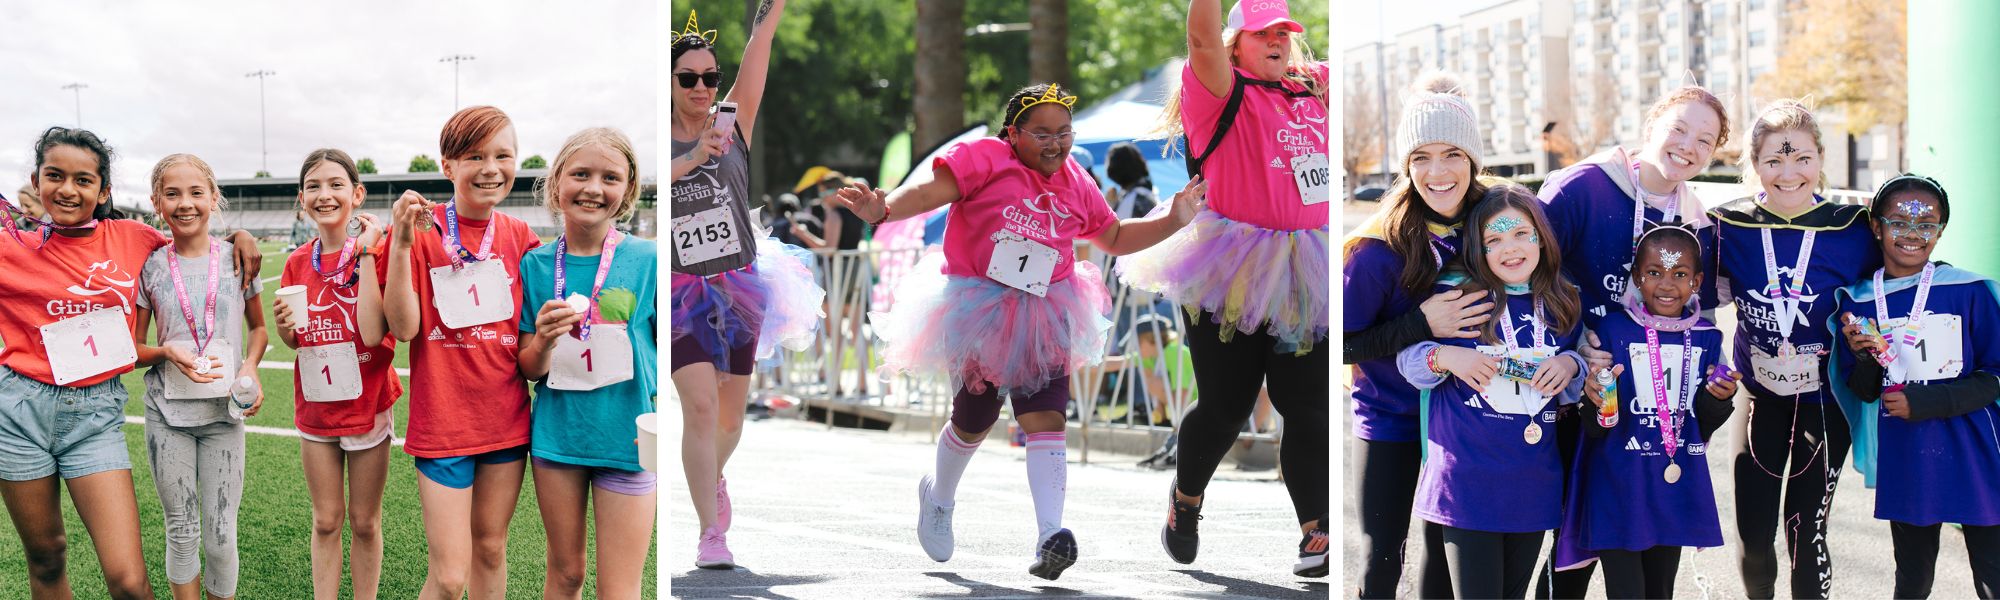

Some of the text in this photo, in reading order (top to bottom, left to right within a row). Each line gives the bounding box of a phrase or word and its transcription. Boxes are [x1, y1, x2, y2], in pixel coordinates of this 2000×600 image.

[671, 182, 701, 198] Girls
[688, 189, 712, 202] run
[447, 210, 456, 228] Girls
[1002, 206, 1040, 230] Girls
[679, 222, 731, 250] 2153
[1005, 222, 1048, 240] the run
[1018, 254, 1028, 272] 1
[468, 284, 480, 306] 1
[556, 277, 564, 294] Run
[1911, 301, 1922, 322] Girls
[1921, 269, 1931, 284] Run
[181, 299, 193, 319] Girls
[1735, 297, 1776, 320] Girls
[1877, 296, 1885, 312] Run
[312, 329, 344, 342] run
[1504, 325, 1513, 342] Run
[83, 334, 98, 357] 1
[1914, 338, 1926, 362] 1
[580, 348, 592, 372] 1
[1646, 328, 1665, 402] Girls on the Run
[322, 365, 332, 385] 1
[1664, 368, 1672, 390] 1
[1679, 384, 1687, 410] Girls
[1683, 338, 1691, 359] Run
[1758, 367, 1810, 382] COACH
[1812, 468, 1841, 566] MOUNTAIN
